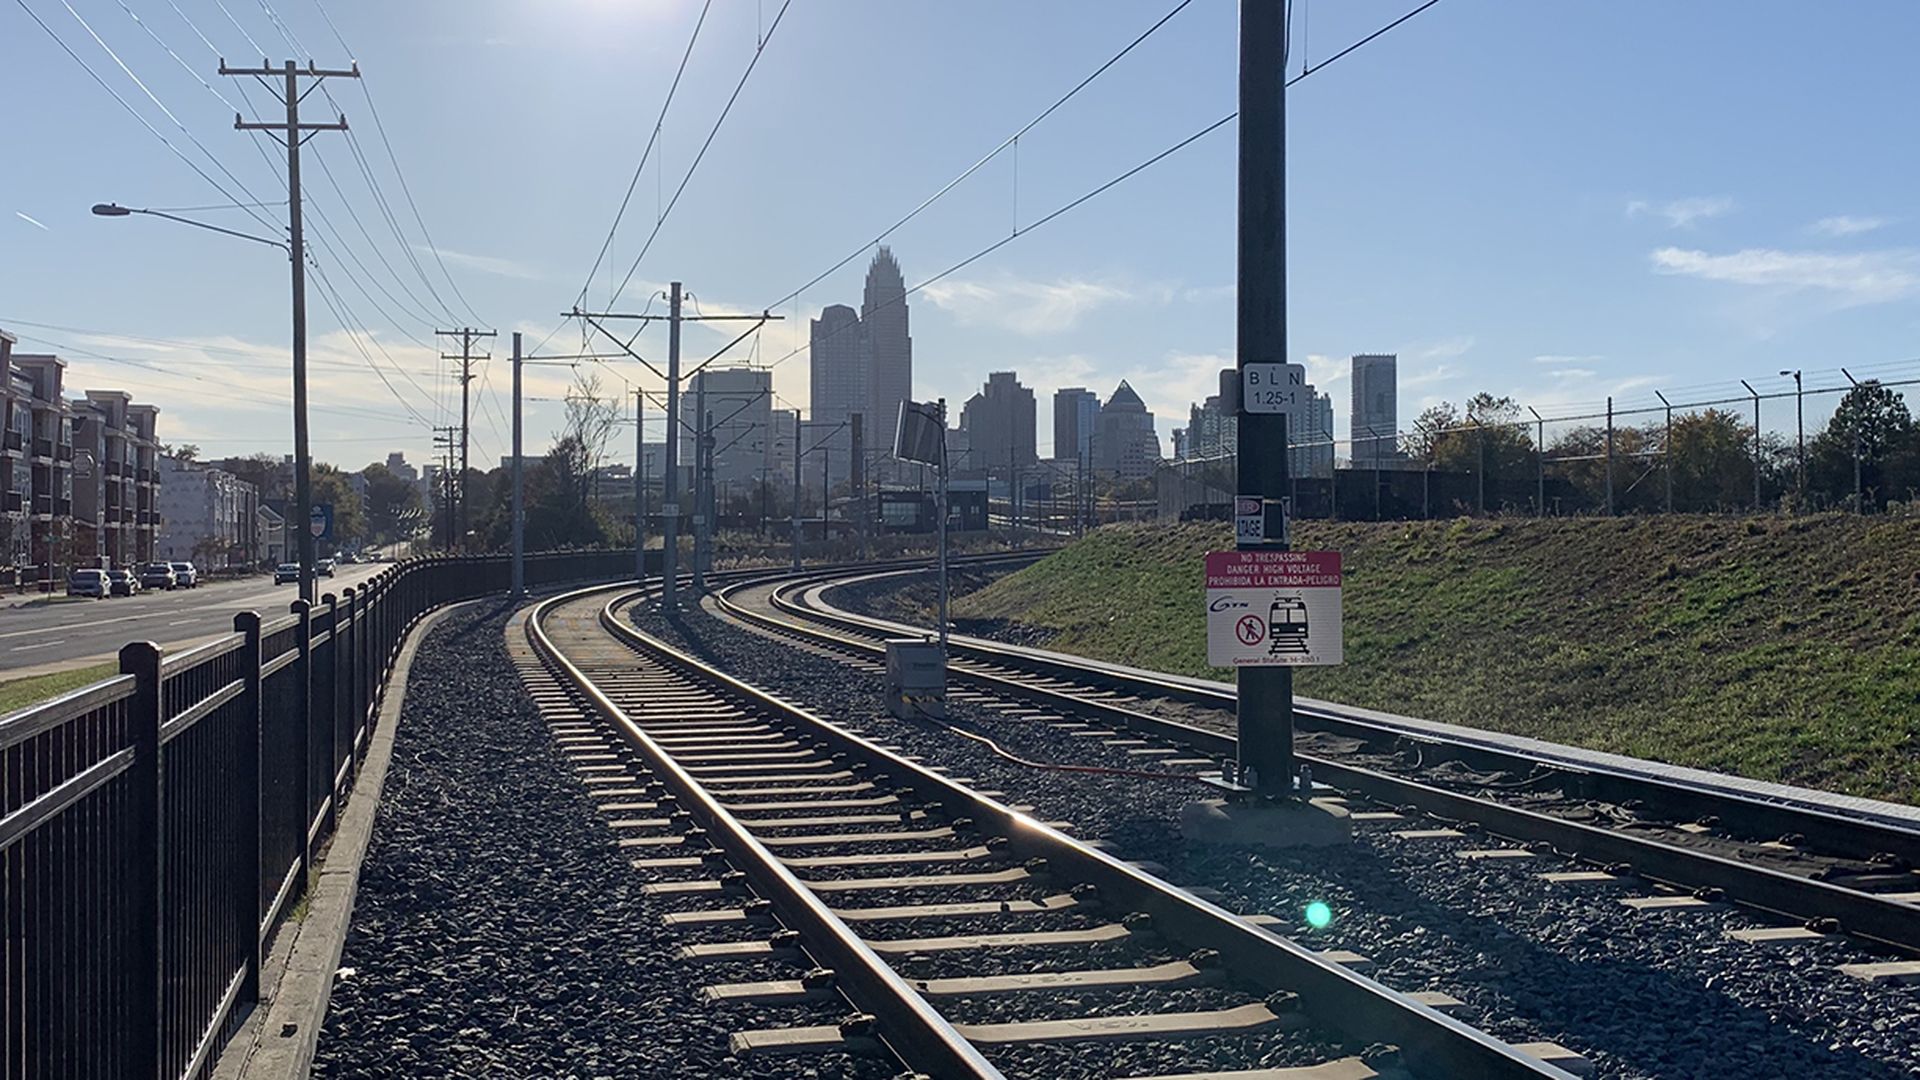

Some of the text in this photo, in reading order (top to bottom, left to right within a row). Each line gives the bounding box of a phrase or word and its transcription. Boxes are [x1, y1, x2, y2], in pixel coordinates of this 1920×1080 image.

[1254, 391, 1296, 405] 1.25-1
[1240, 553, 1308, 563] NO TRESPASSING
[1226, 564, 1321, 575] DANGER HIGH VOLTAGE
[1208, 576, 1252, 586] PROHIBIDA
[1254, 576, 1266, 586] LA
[1232, 656, 1260, 665] General
